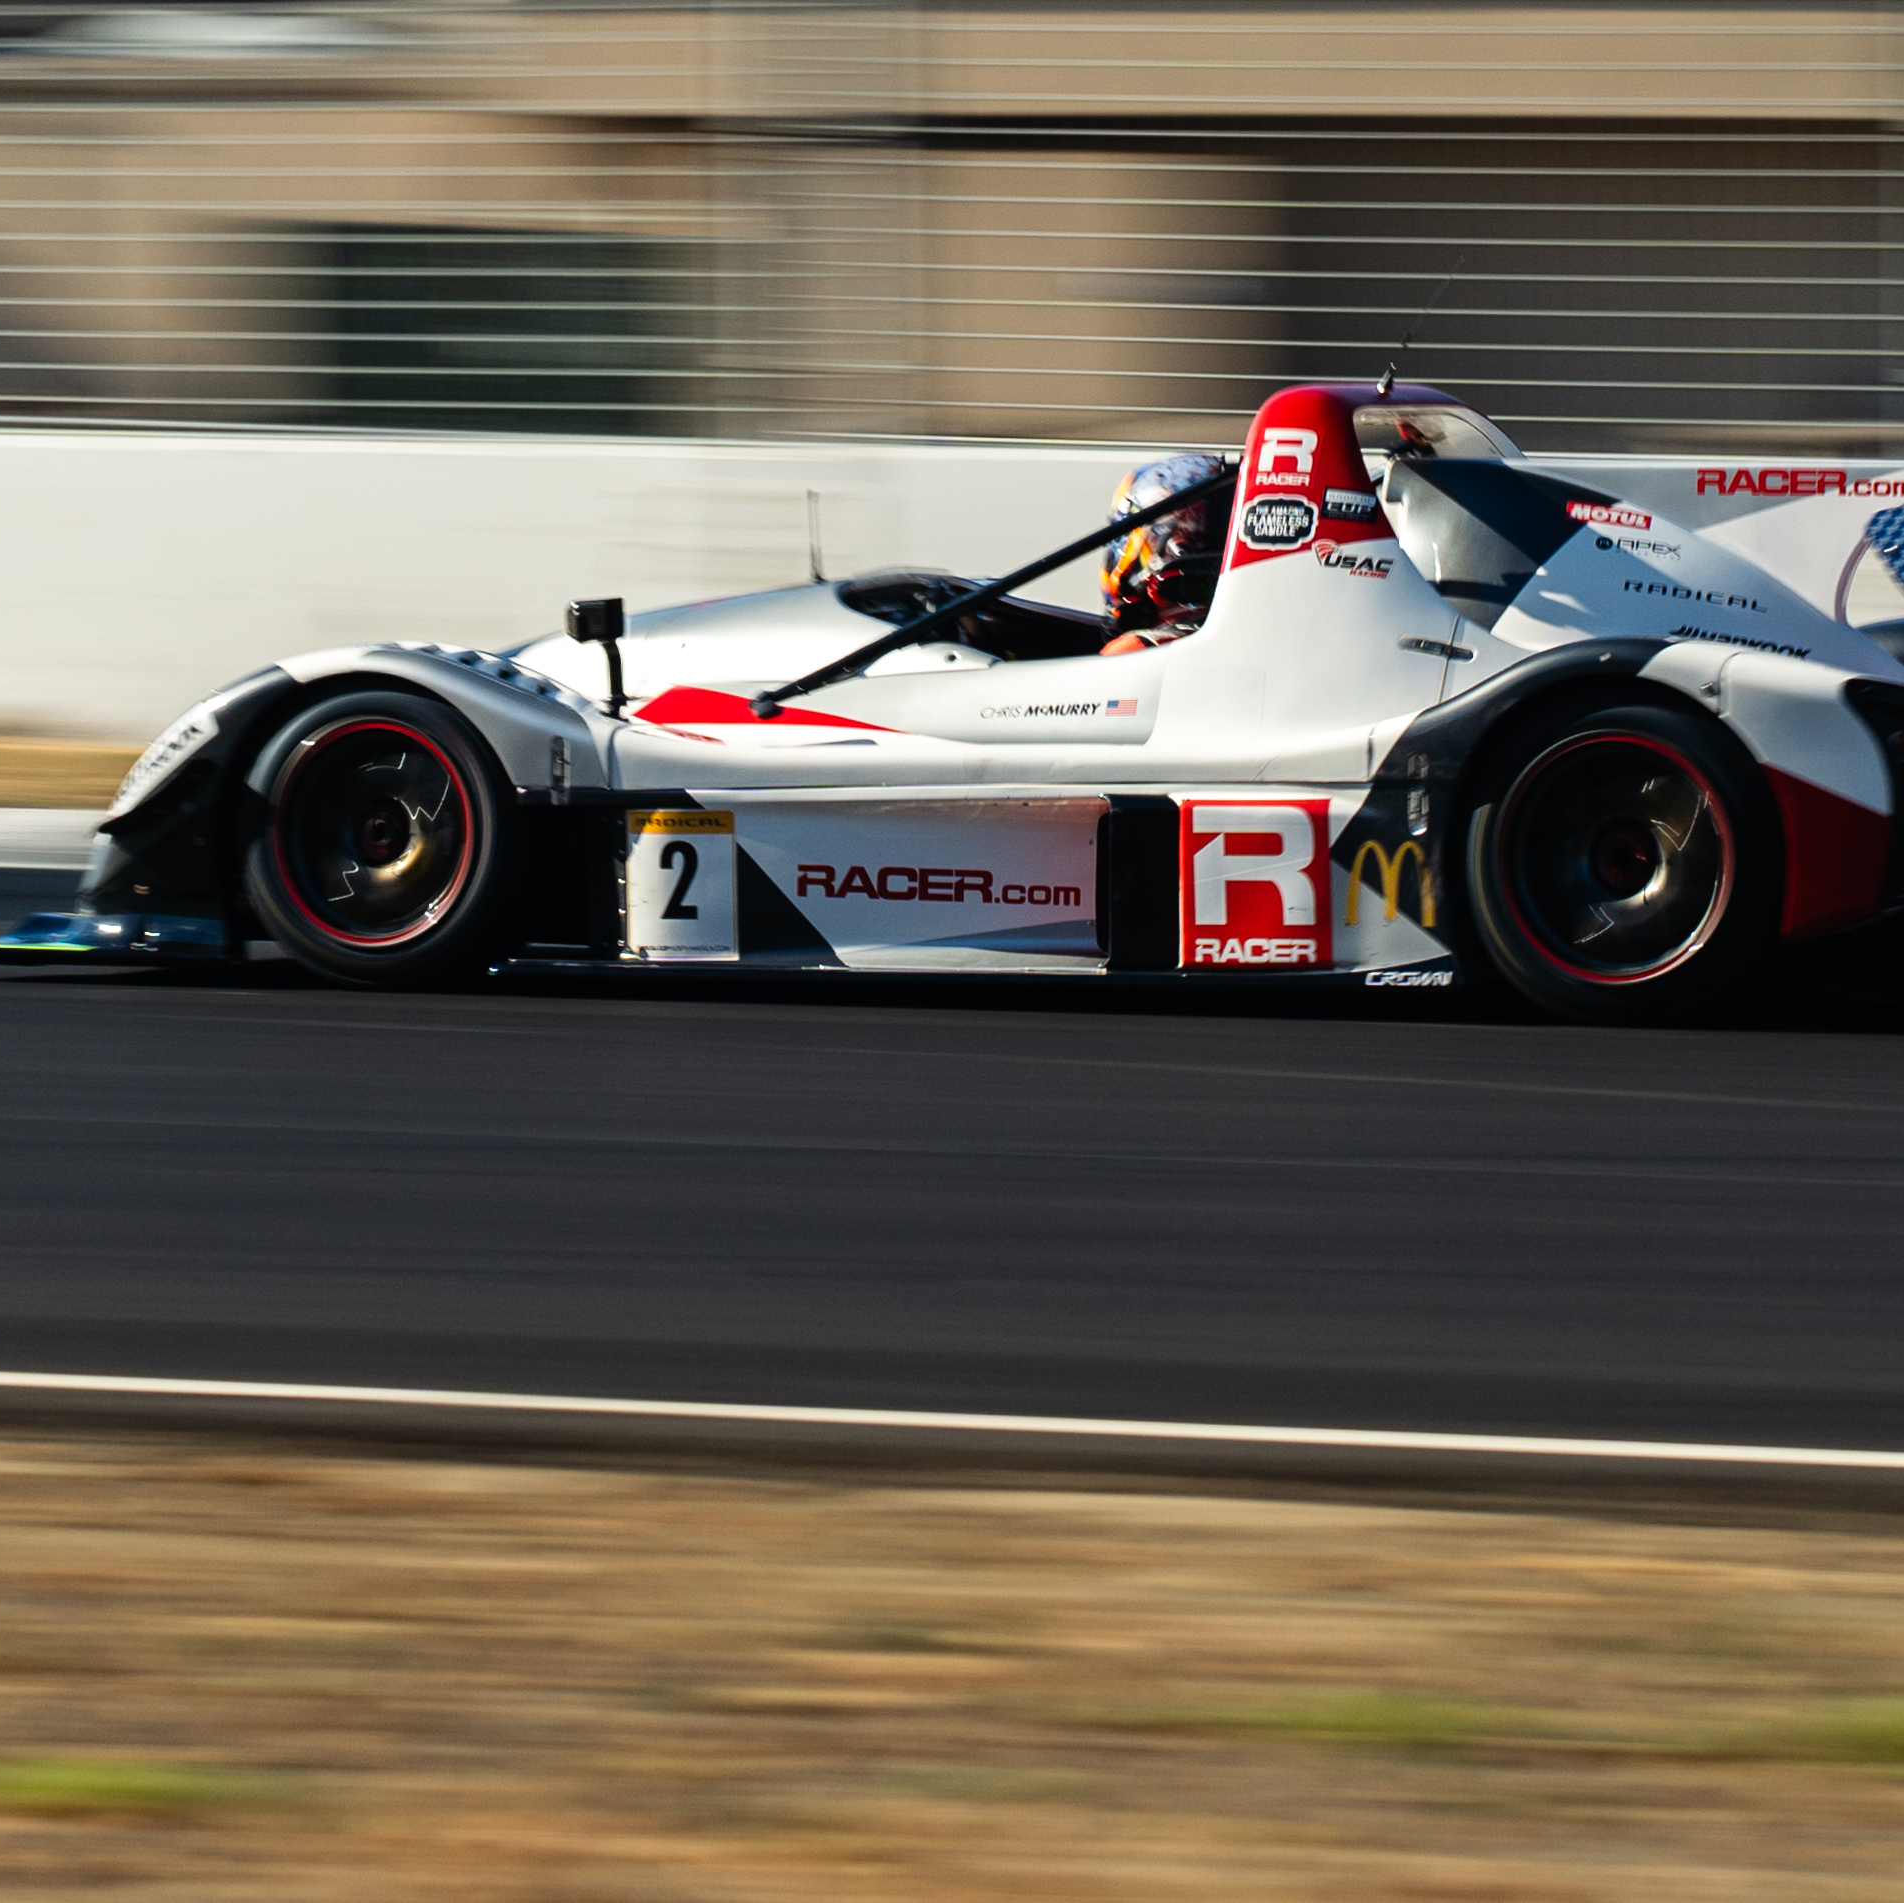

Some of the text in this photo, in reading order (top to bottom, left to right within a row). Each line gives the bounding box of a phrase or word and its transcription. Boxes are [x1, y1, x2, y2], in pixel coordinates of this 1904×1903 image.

[1258, 428, 1318, 472] R
[1255, 472, 1310, 487] RACER
[1247, 513, 1310, 528] FLAMELESS
[1571, 503, 1647, 527] MOTUL
[1254, 524, 1296, 536] CANDLE
[1617, 536, 1681, 558] APEX
[1324, 555, 1394, 573] USAC
[1624, 579, 1769, 614] RADICAL
[980, 705, 1022, 719] CHRIS
[635, 817, 727, 827] RADICAL
[1193, 805, 1317, 926] R
[659, 840, 699, 920] 2
[797, 864, 1082, 907] RACER.com
[1195, 938, 1317, 963] RACER
